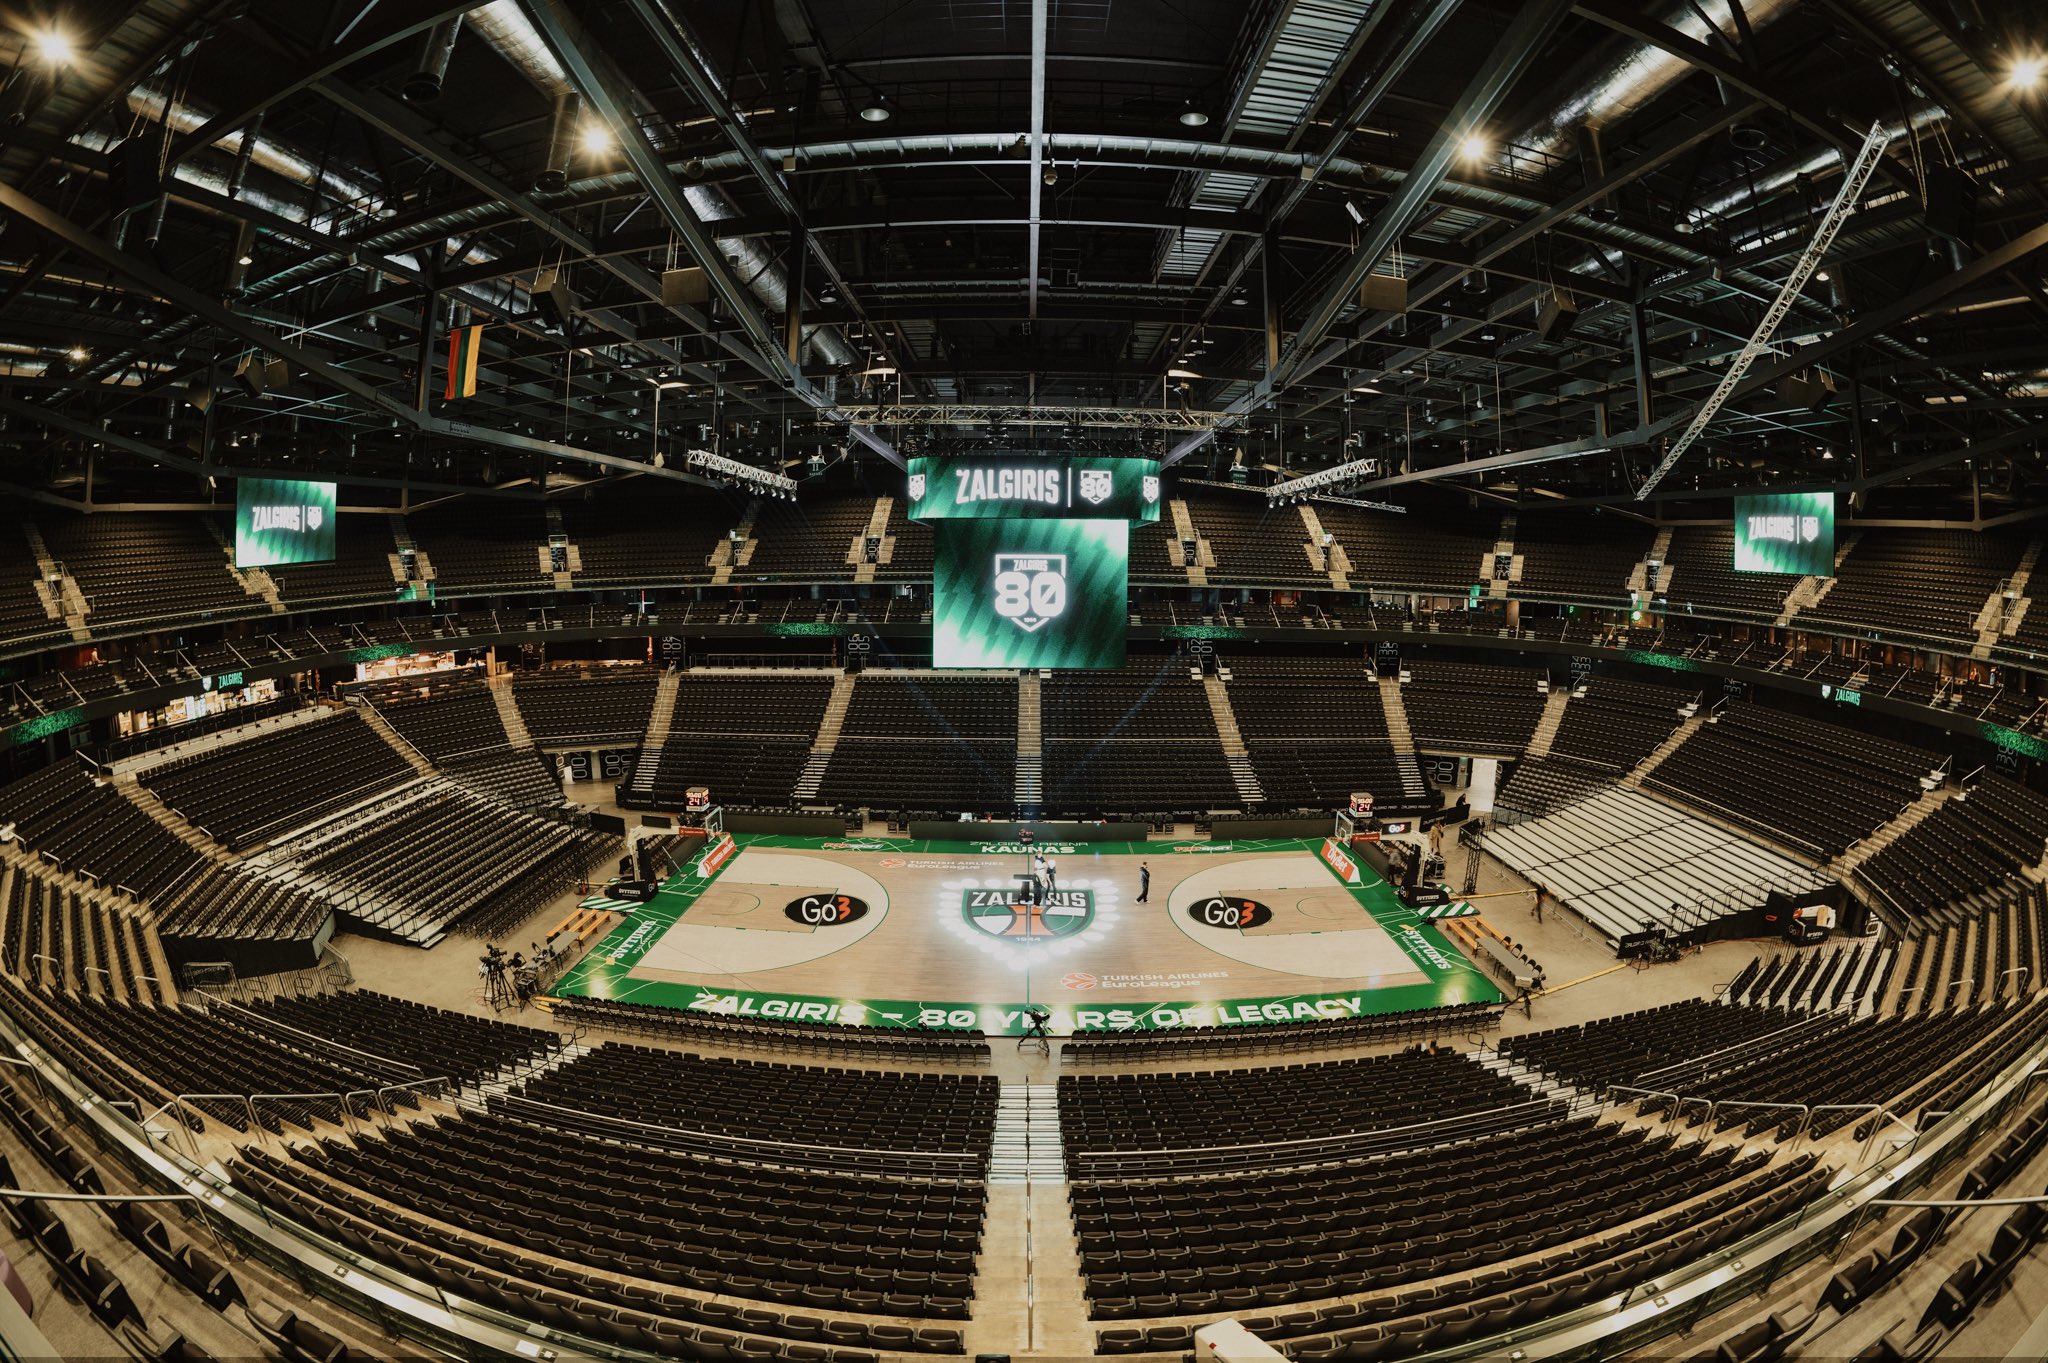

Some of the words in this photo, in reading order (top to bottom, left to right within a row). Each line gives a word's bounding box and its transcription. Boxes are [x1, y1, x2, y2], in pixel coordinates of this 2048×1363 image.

[994, 571, 1066, 617] 80
[689, 797, 700, 805] 24
[1358, 803, 1370, 812] 24
[981, 845, 1076, 854] KAUNAS
[1327, 848, 1348, 873] OlyBet
[801, 896, 851, 922] Go3
[1204, 899, 1256, 926] Go3
[1101, 974, 1163, 982] TURKISH
[1167, 971, 1229, 980] AIRLINES
[1101, 979, 1201, 989] EuroLeague
[918, 1009, 977, 1028] 80
[1151, 1006, 1207, 1028] OF
[1216, 996, 1362, 1025] LEGACY
